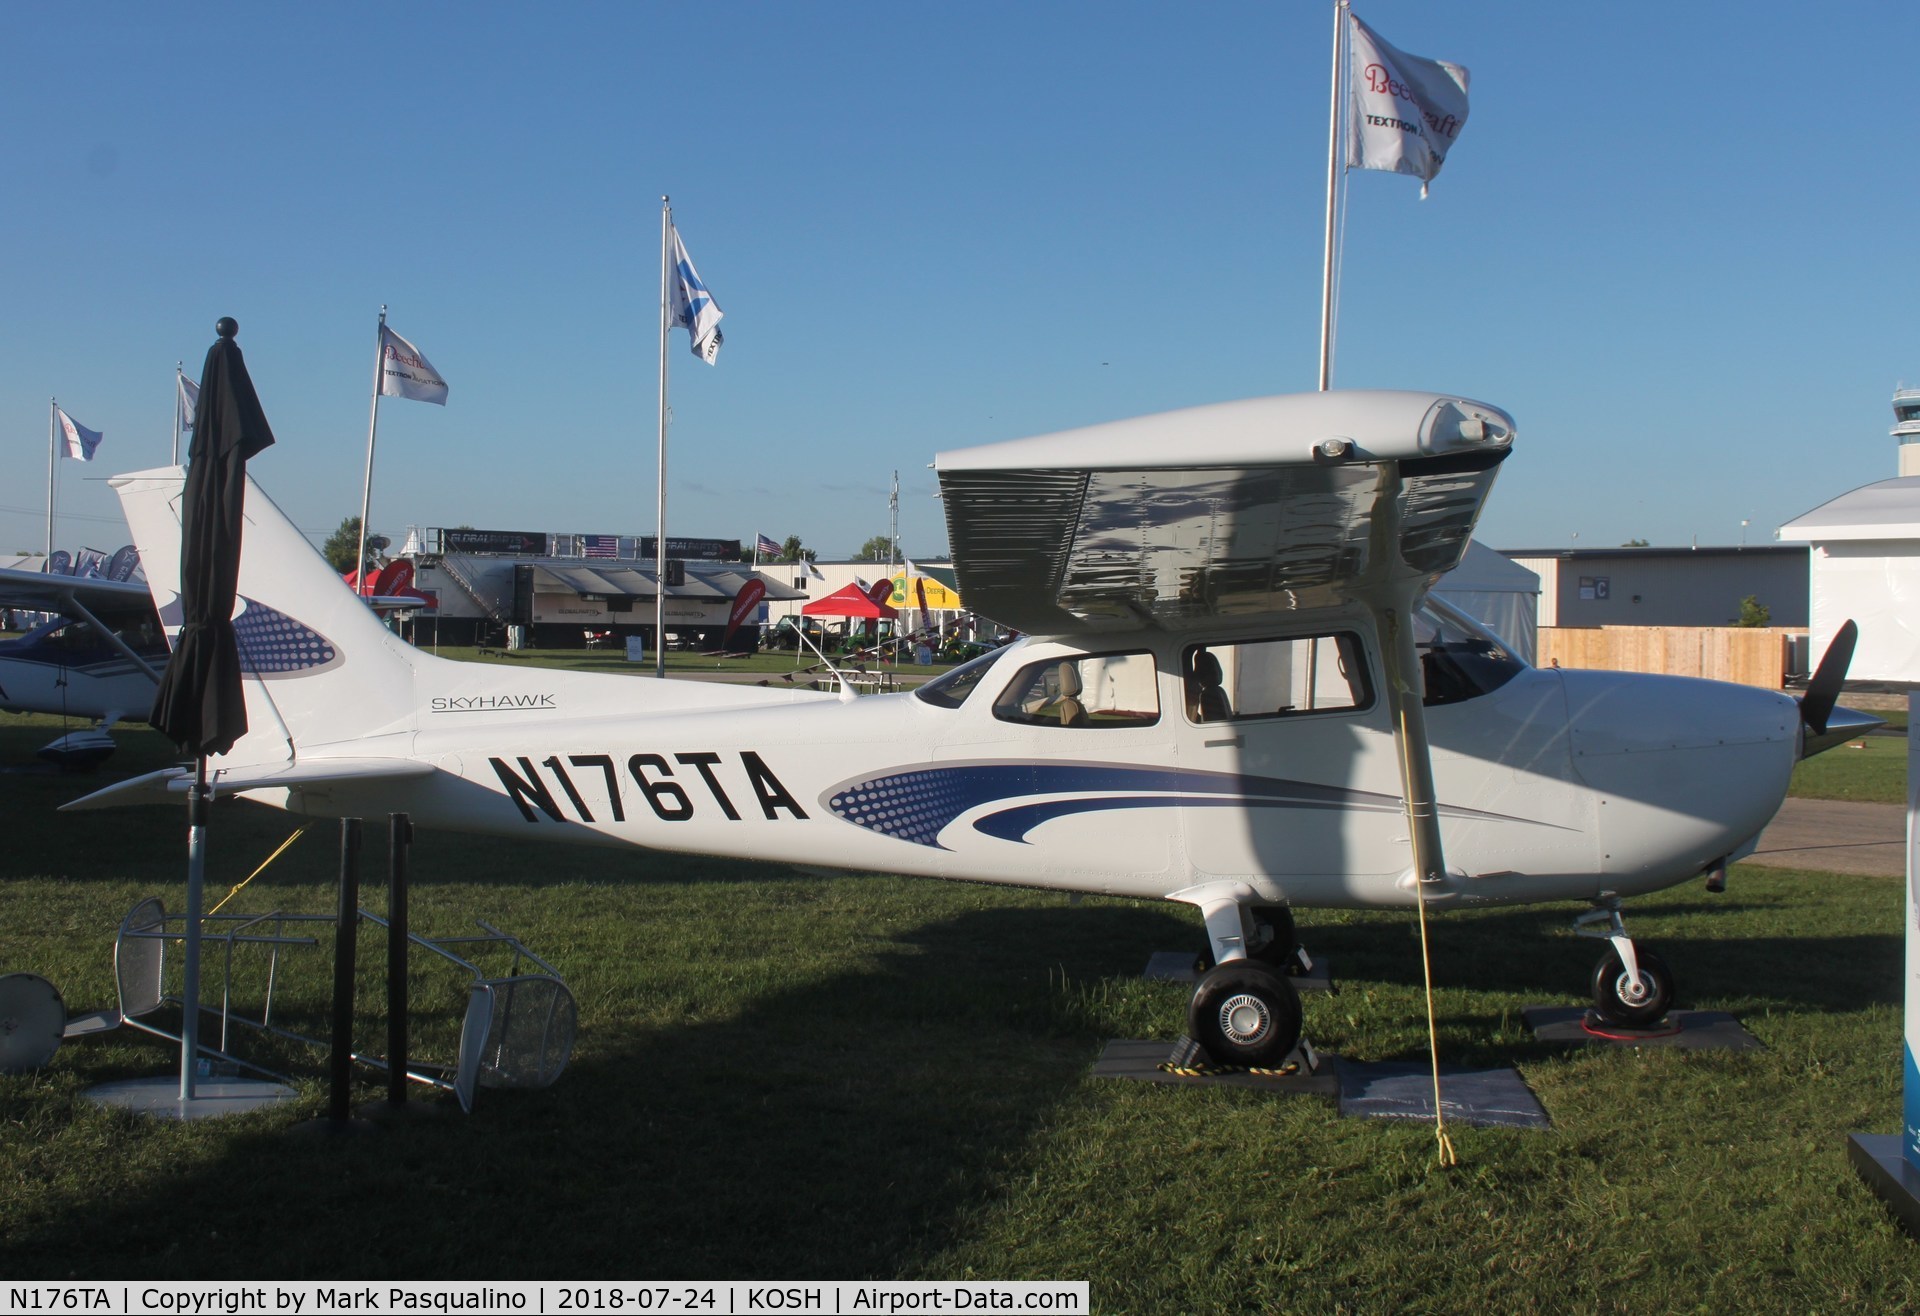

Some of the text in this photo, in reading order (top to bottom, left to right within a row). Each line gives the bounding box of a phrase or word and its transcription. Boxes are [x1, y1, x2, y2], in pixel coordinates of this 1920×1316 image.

[653, 541, 720, 552] GOBALPARTS
[431, 693, 556, 710] SKYHAWK
[487, 751, 811, 823] N176TA
